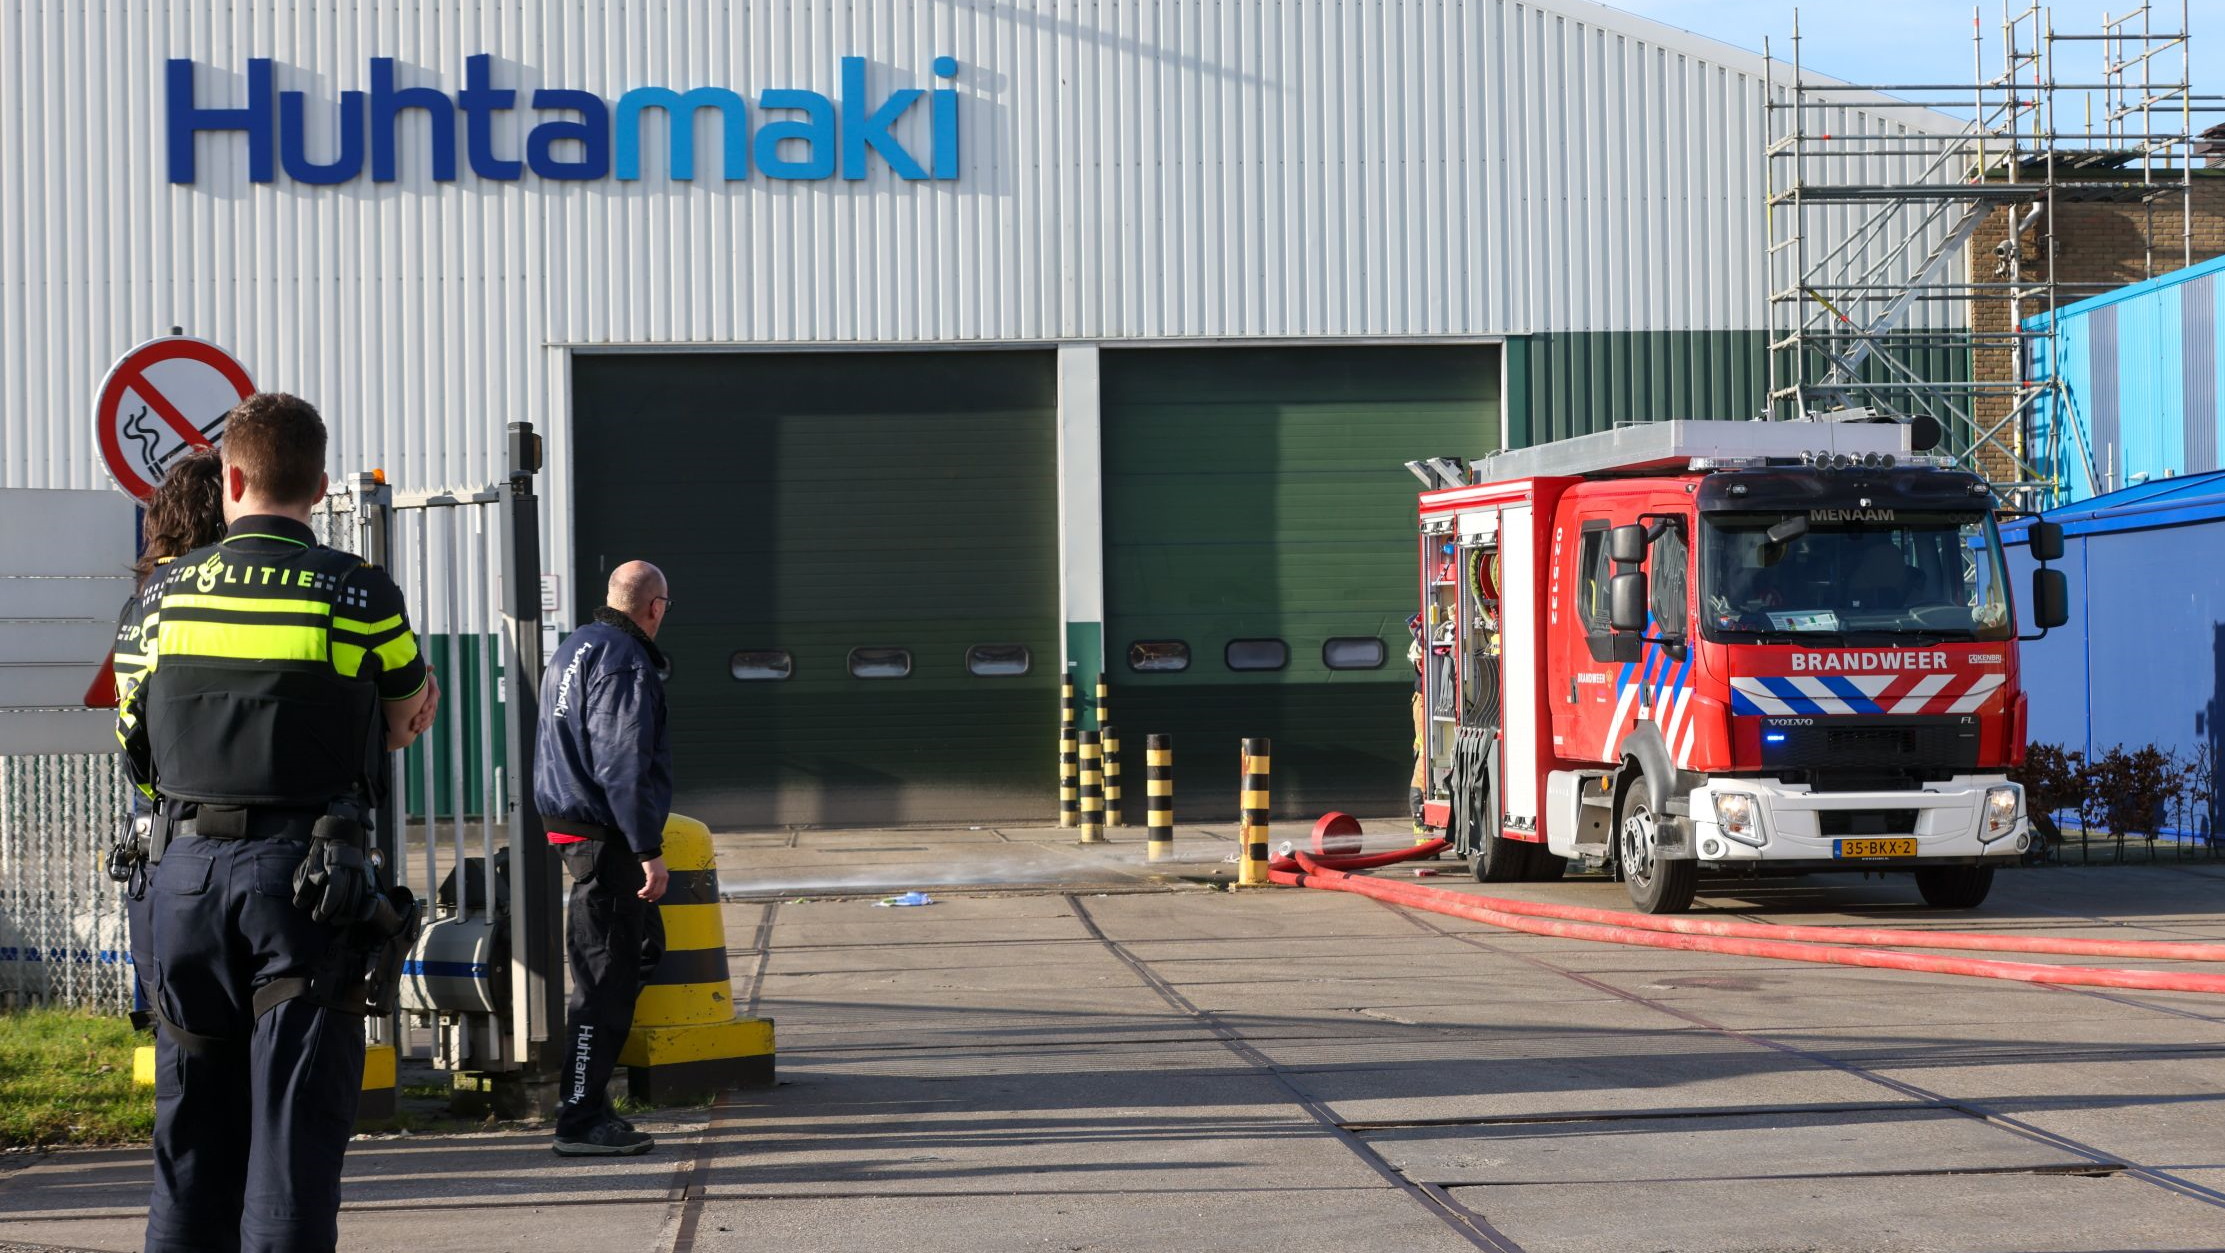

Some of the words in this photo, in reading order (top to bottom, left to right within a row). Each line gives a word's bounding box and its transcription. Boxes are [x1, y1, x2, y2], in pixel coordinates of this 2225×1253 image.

[167, 54, 959, 186] Huhtamaki
[1810, 508, 1895, 521] MENAAM
[181, 556, 315, 593] POLITIE
[1551, 527, 1563, 625] 02-5132
[1791, 651, 1948, 671] BRANDWEER
[554, 641, 592, 718] Huhtamaki
[1767, 718, 1814, 726] VOLVO
[1960, 716, 1975, 725] FL
[1845, 841, 1911, 855] 35-BKX-2
